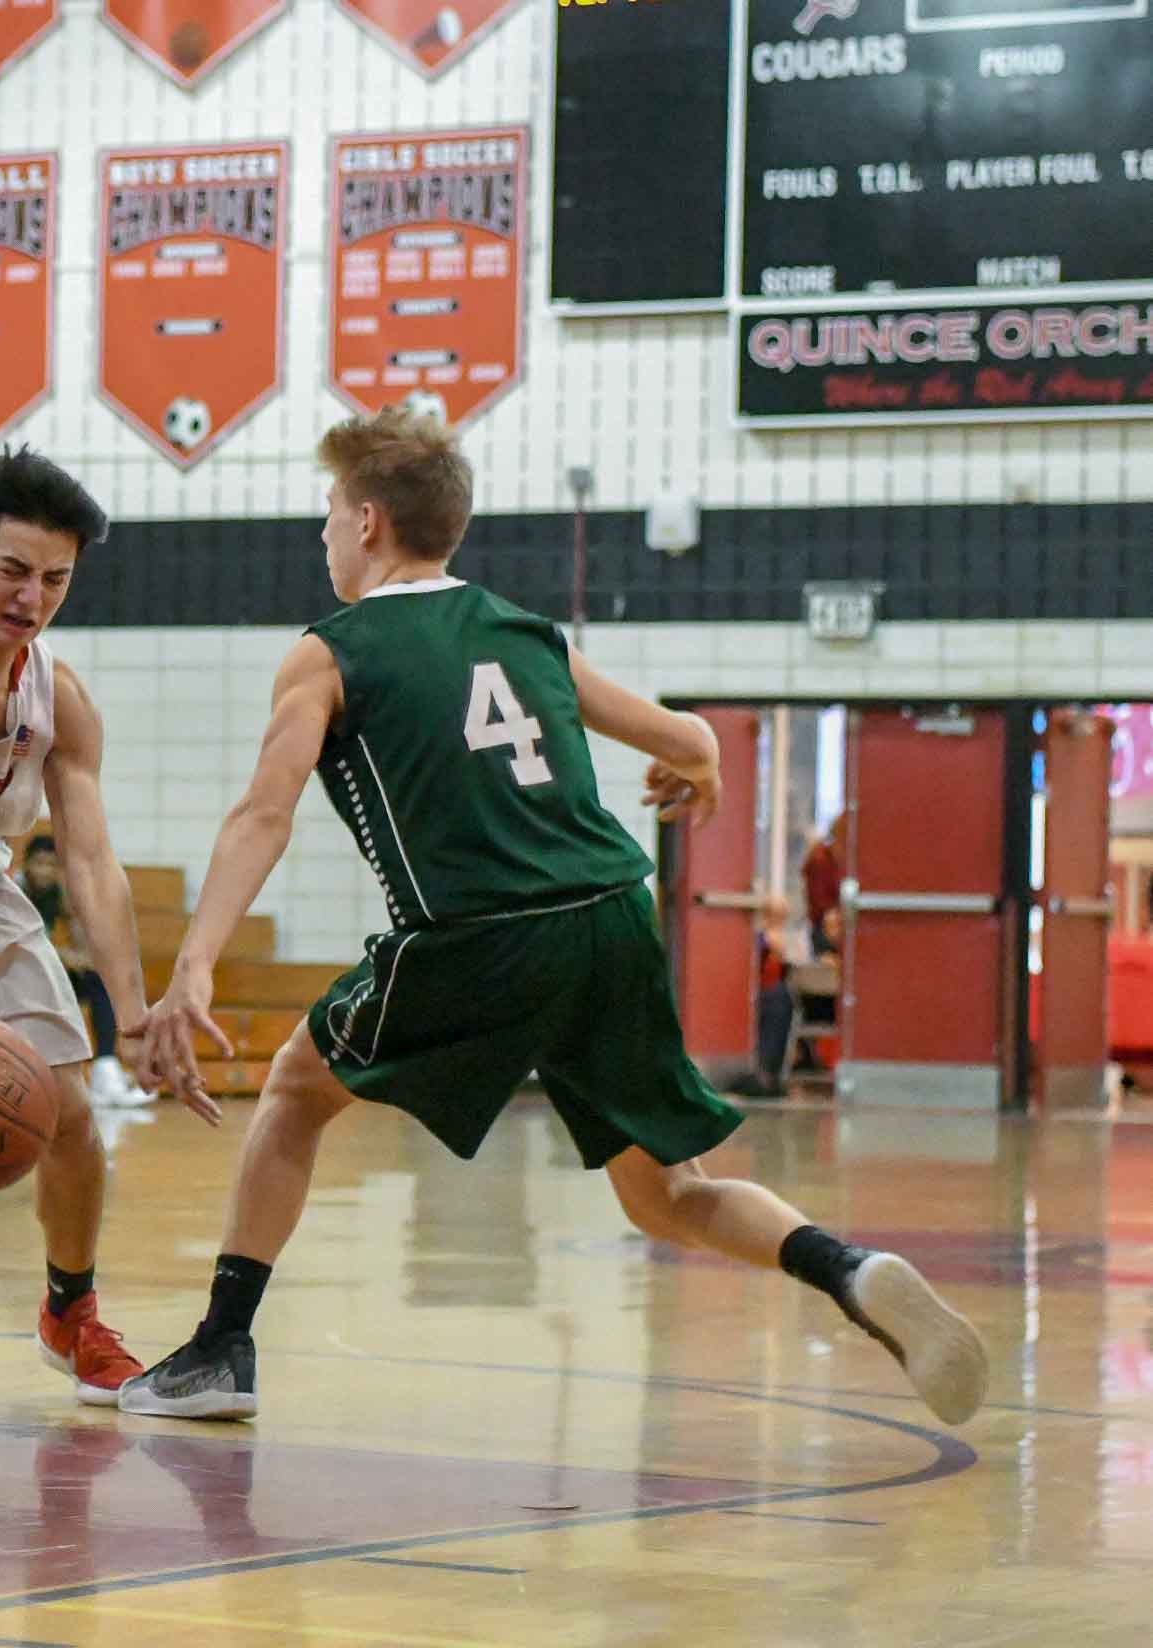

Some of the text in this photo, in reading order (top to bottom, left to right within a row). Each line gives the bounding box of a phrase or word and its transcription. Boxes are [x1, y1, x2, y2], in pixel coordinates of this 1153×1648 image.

[751, 33, 907, 83] COUGARS
[979, 44, 1065, 78] PERIOD
[184, 154, 278, 181] SOCCER
[762, 166, 838, 199] FOULS
[947, 152, 1101, 191] PLAYER FOUL
[761, 266, 836, 295] SCORE
[976, 256, 1061, 285] MATCH
[748, 311, 981, 373] QUINCE
[463, 662, 553, 786] 4
